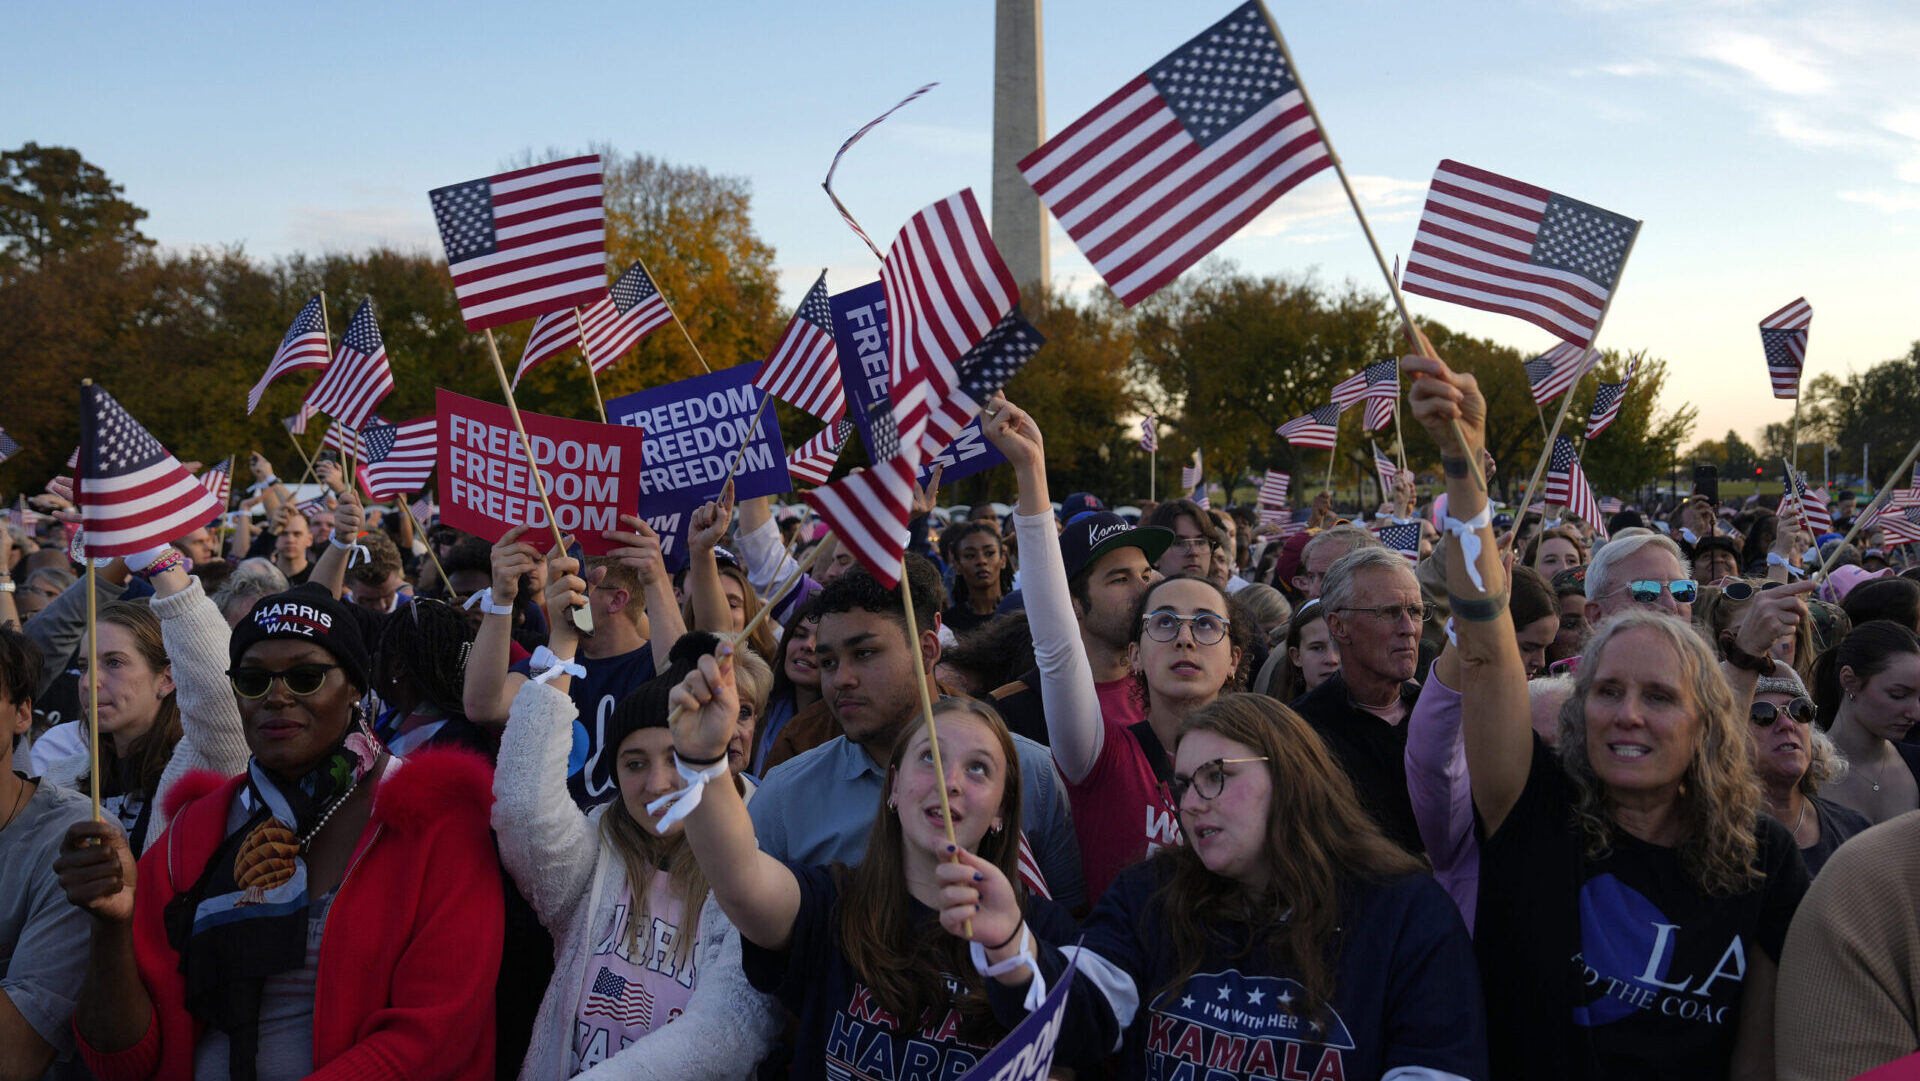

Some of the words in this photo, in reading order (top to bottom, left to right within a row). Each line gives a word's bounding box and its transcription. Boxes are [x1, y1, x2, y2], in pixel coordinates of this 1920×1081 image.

[450, 413, 621, 473] FREEDOM
[641, 414, 766, 467] REEDOM
[450, 445, 619, 503] FREEDOM
[640, 443, 775, 496] FREEDOM
[451, 477, 617, 531] FREEDOM
[254, 603, 333, 629] HARRIS
[266, 621, 314, 637] WALZ
[1203, 1002, 1229, 1022] I'M
[1230, 1008, 1266, 1029] WITH
[1266, 1013, 1299, 1029] HER
[1606, 976, 1657, 1010] THE
[1661, 996, 1728, 1024] COAC
[826, 1010, 978, 1081] HARR
[1147, 1014, 1345, 1081] KAMALA
